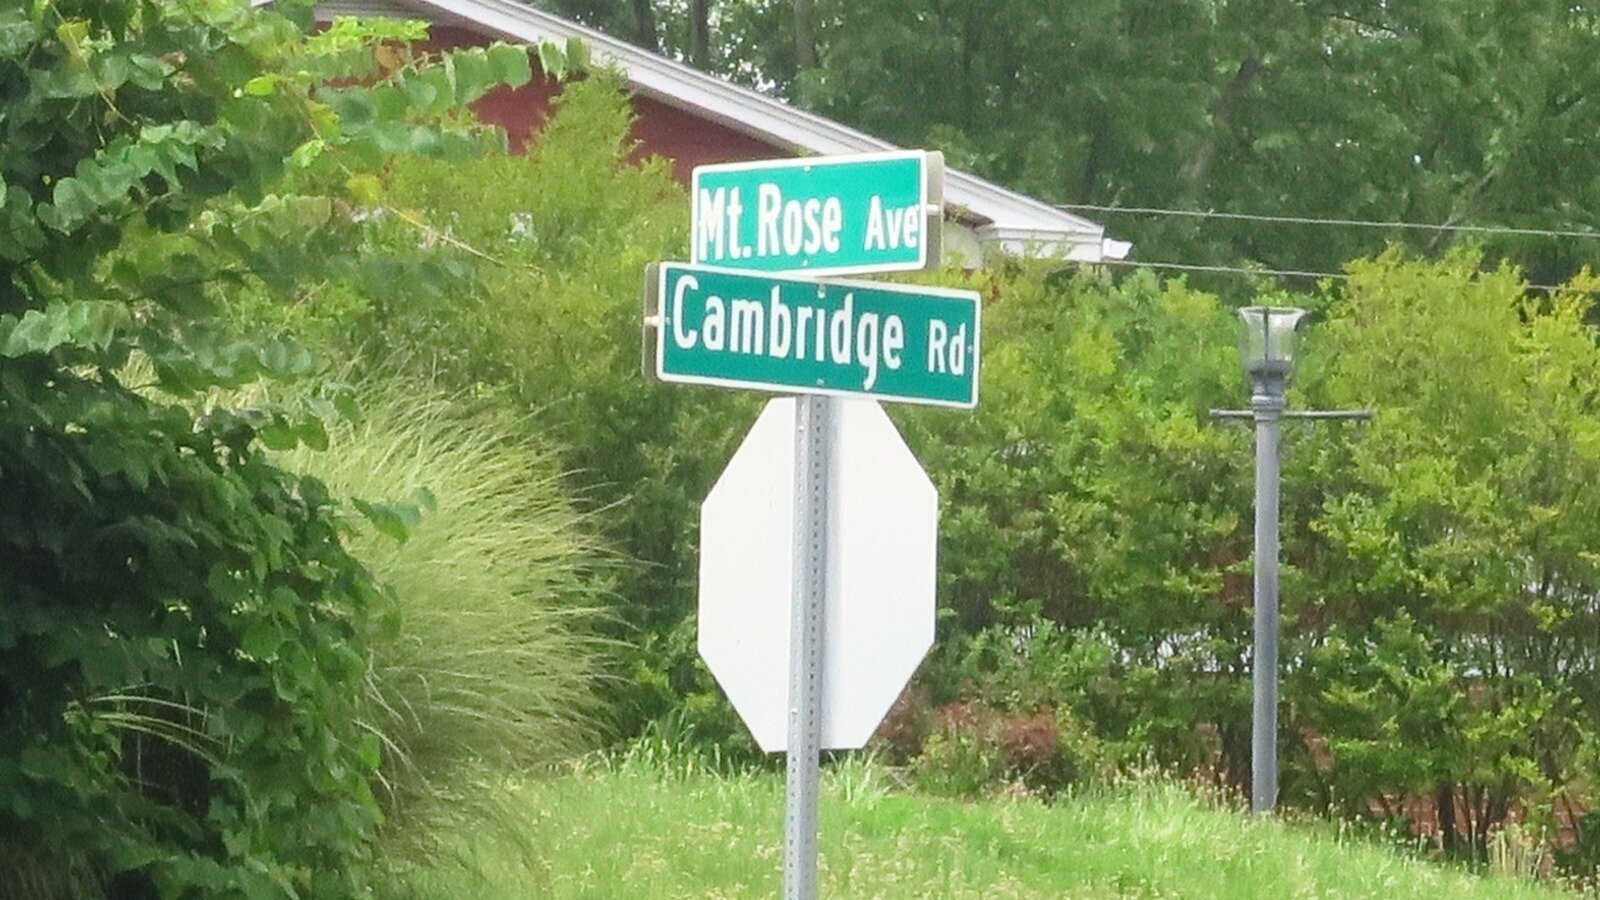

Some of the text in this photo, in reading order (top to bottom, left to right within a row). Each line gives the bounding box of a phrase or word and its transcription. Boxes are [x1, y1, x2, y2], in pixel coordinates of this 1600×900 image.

[699, 183, 918, 261] Mt. Rose Ave
[673, 274, 966, 390] Cambridge Rd
